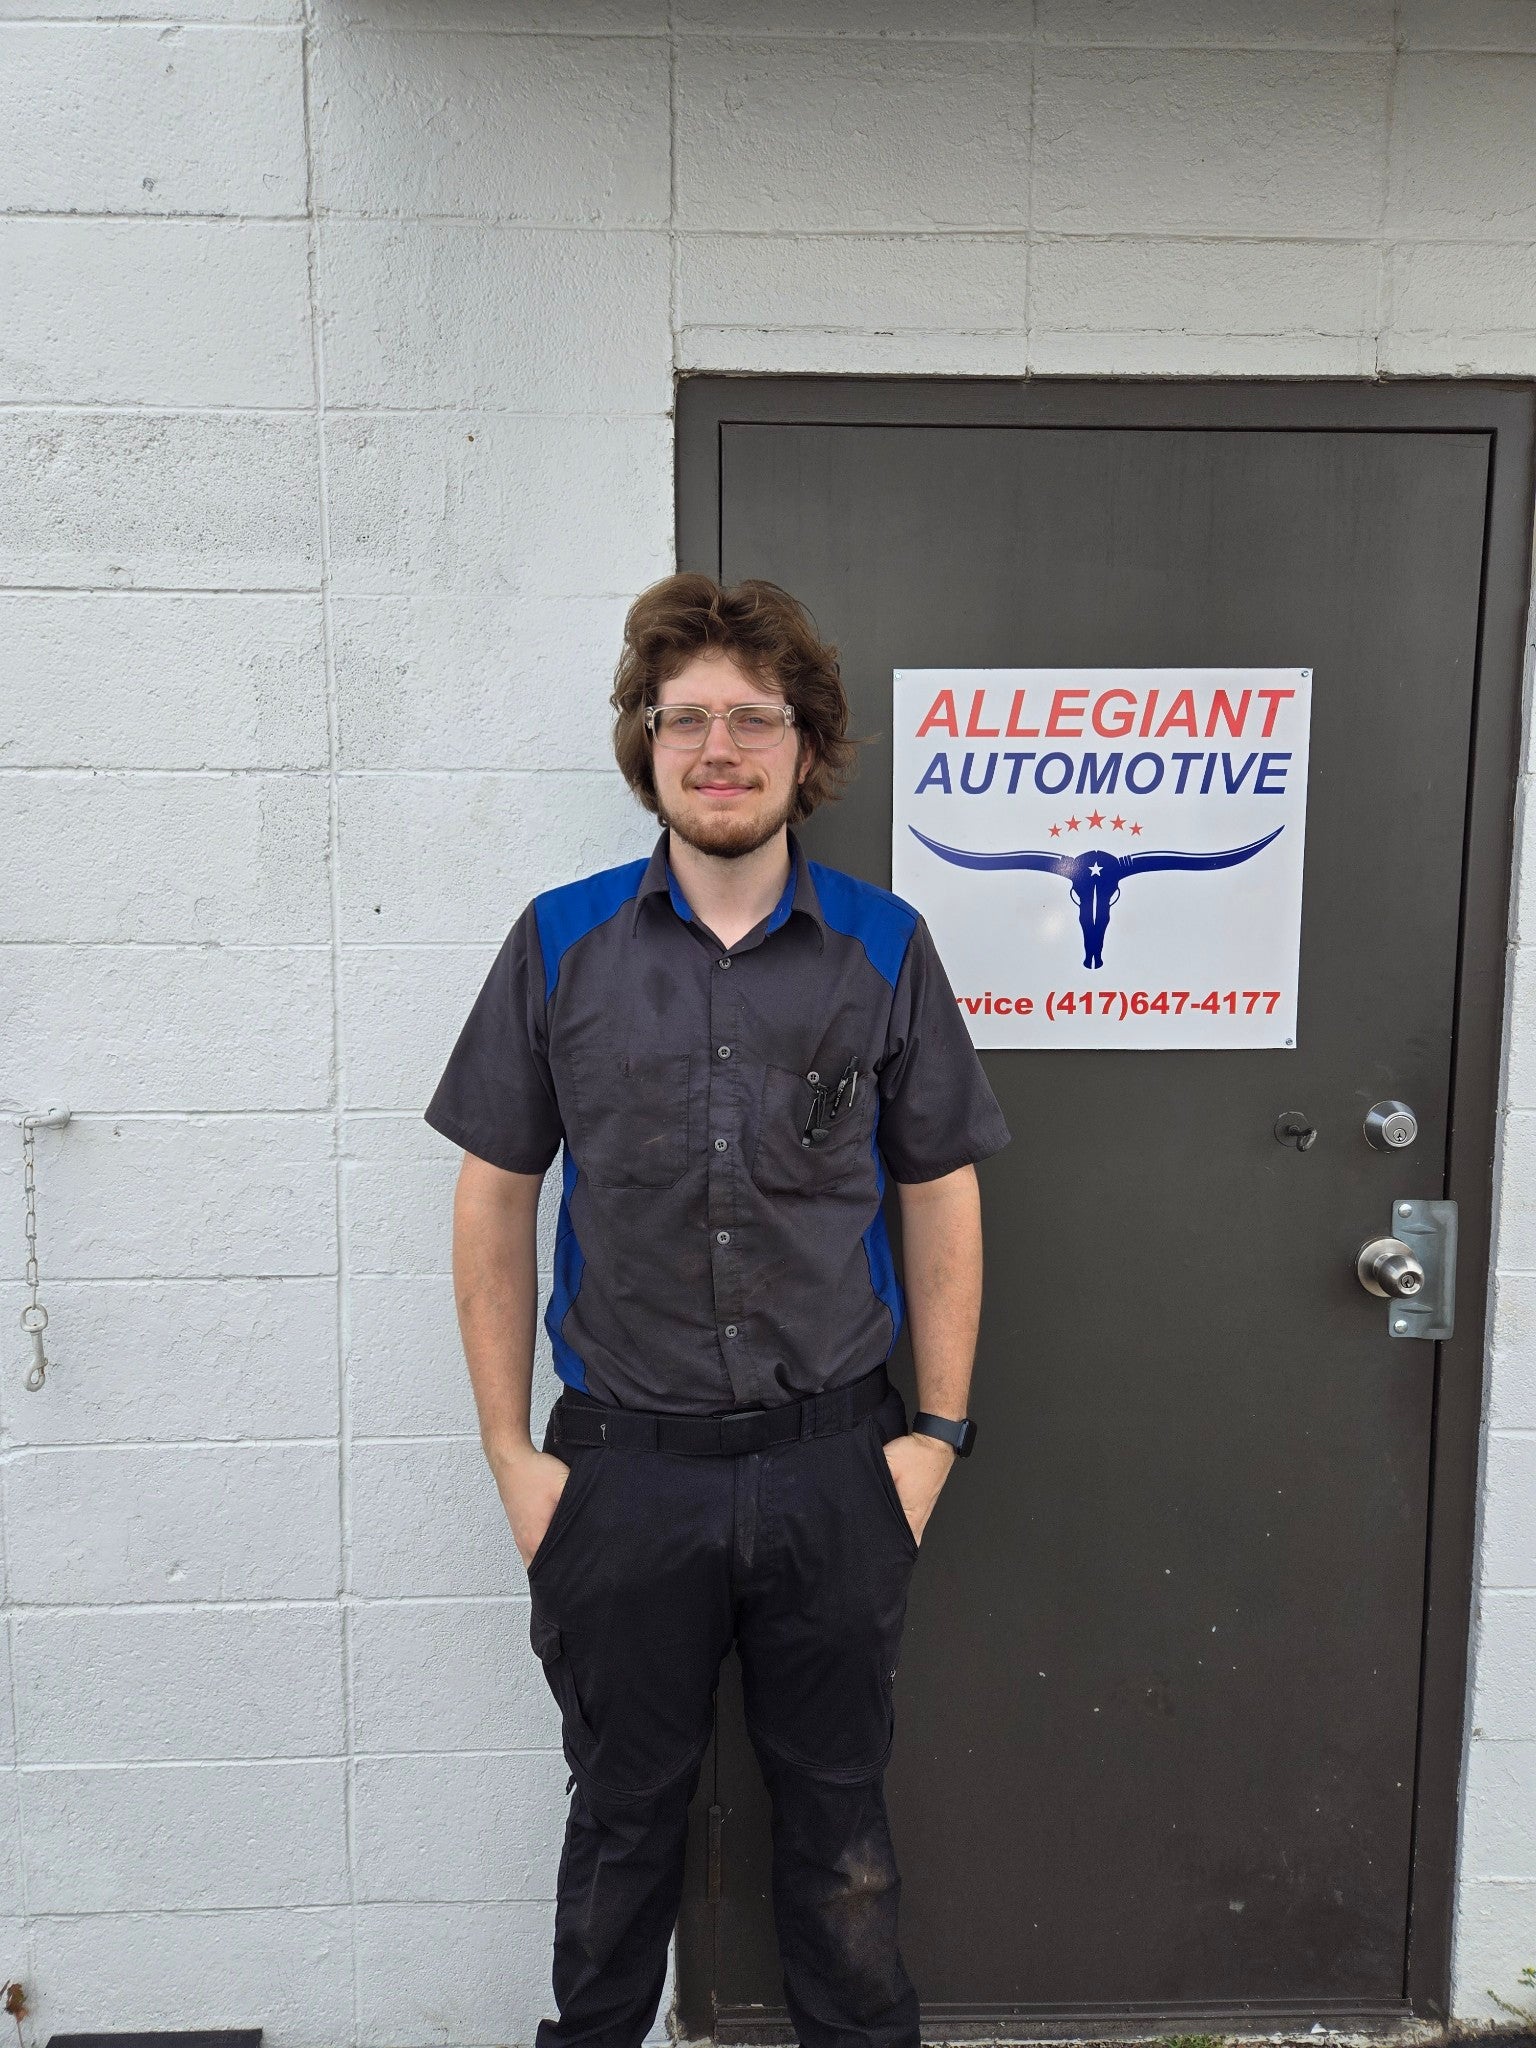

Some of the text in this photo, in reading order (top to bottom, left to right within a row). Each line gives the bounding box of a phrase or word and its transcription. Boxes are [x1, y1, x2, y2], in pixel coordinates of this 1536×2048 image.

[916, 688, 1296, 739] ALLEGIANT
[914, 751, 1293, 795] AUTOMOTIVE
[1045, 991, 1281, 1021] (417)647-4177
